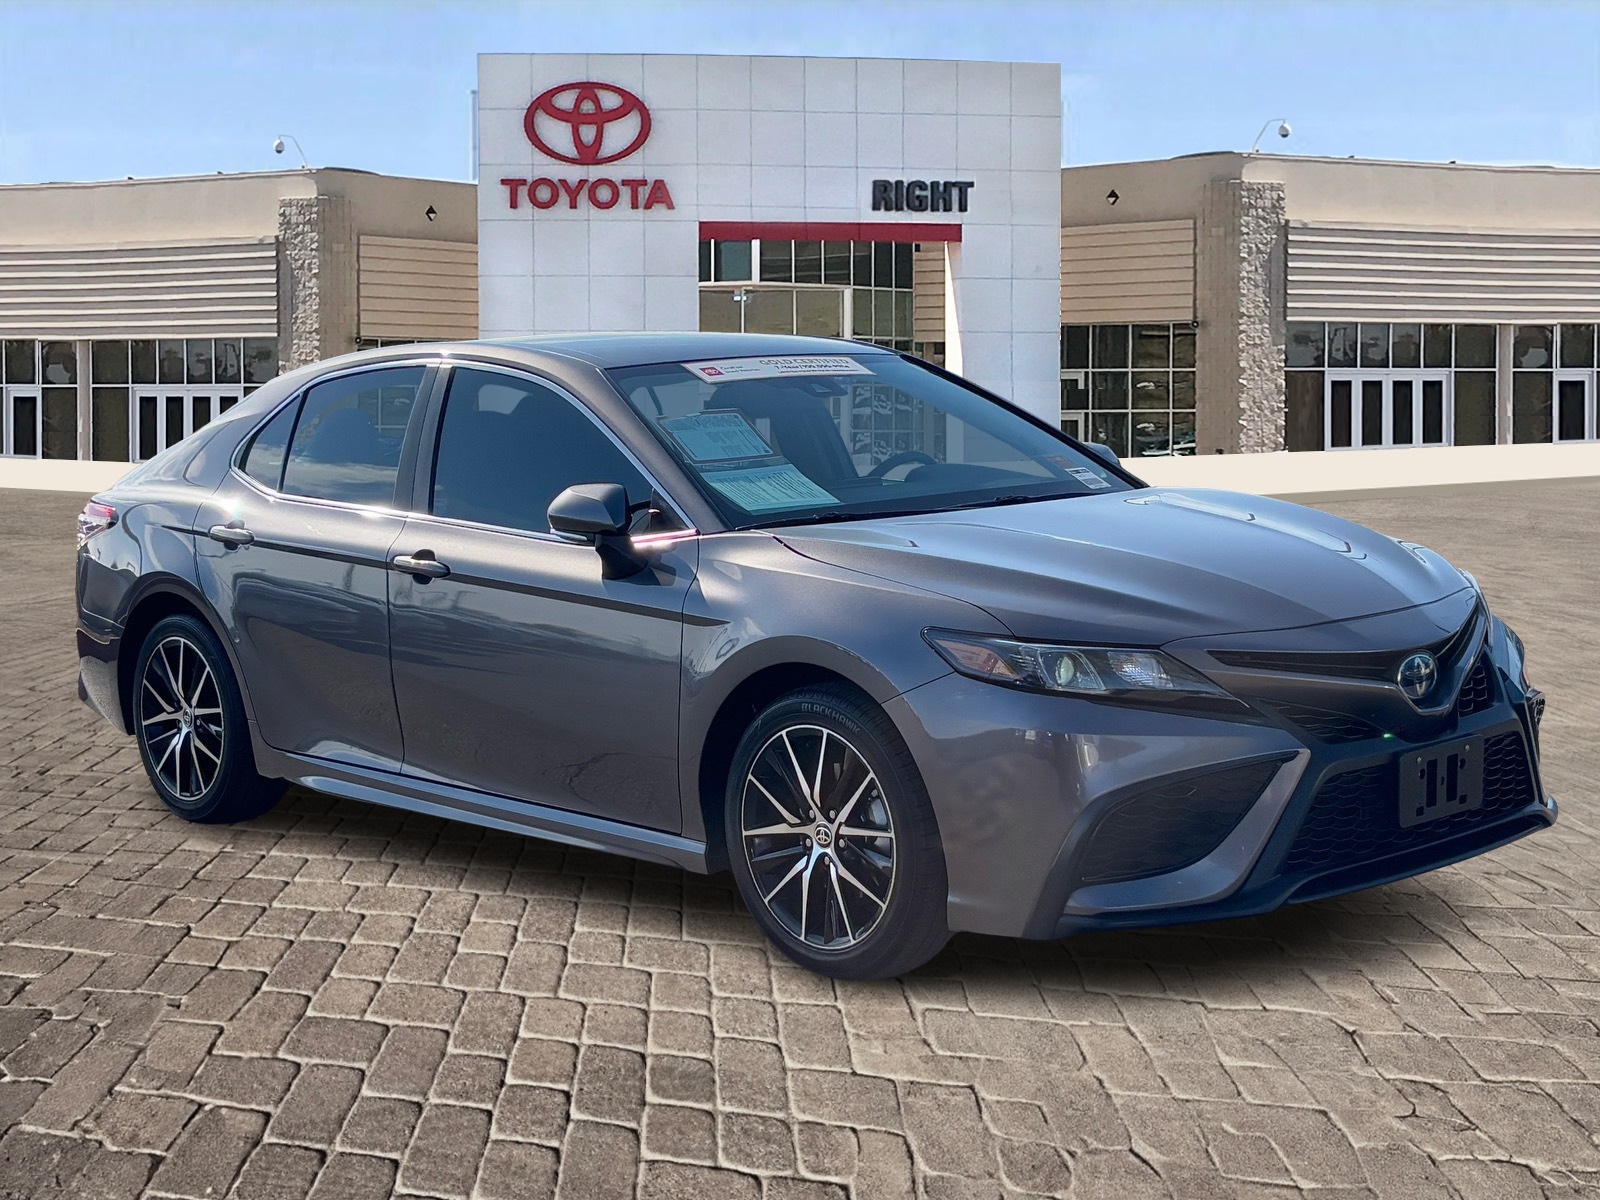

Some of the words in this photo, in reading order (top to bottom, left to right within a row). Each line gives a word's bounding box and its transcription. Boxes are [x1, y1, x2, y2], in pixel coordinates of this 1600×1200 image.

[500, 178, 675, 210] TOYOTA
[872, 179, 975, 212] RIGHT
[802, 703, 861, 734] BLACKHAWK
